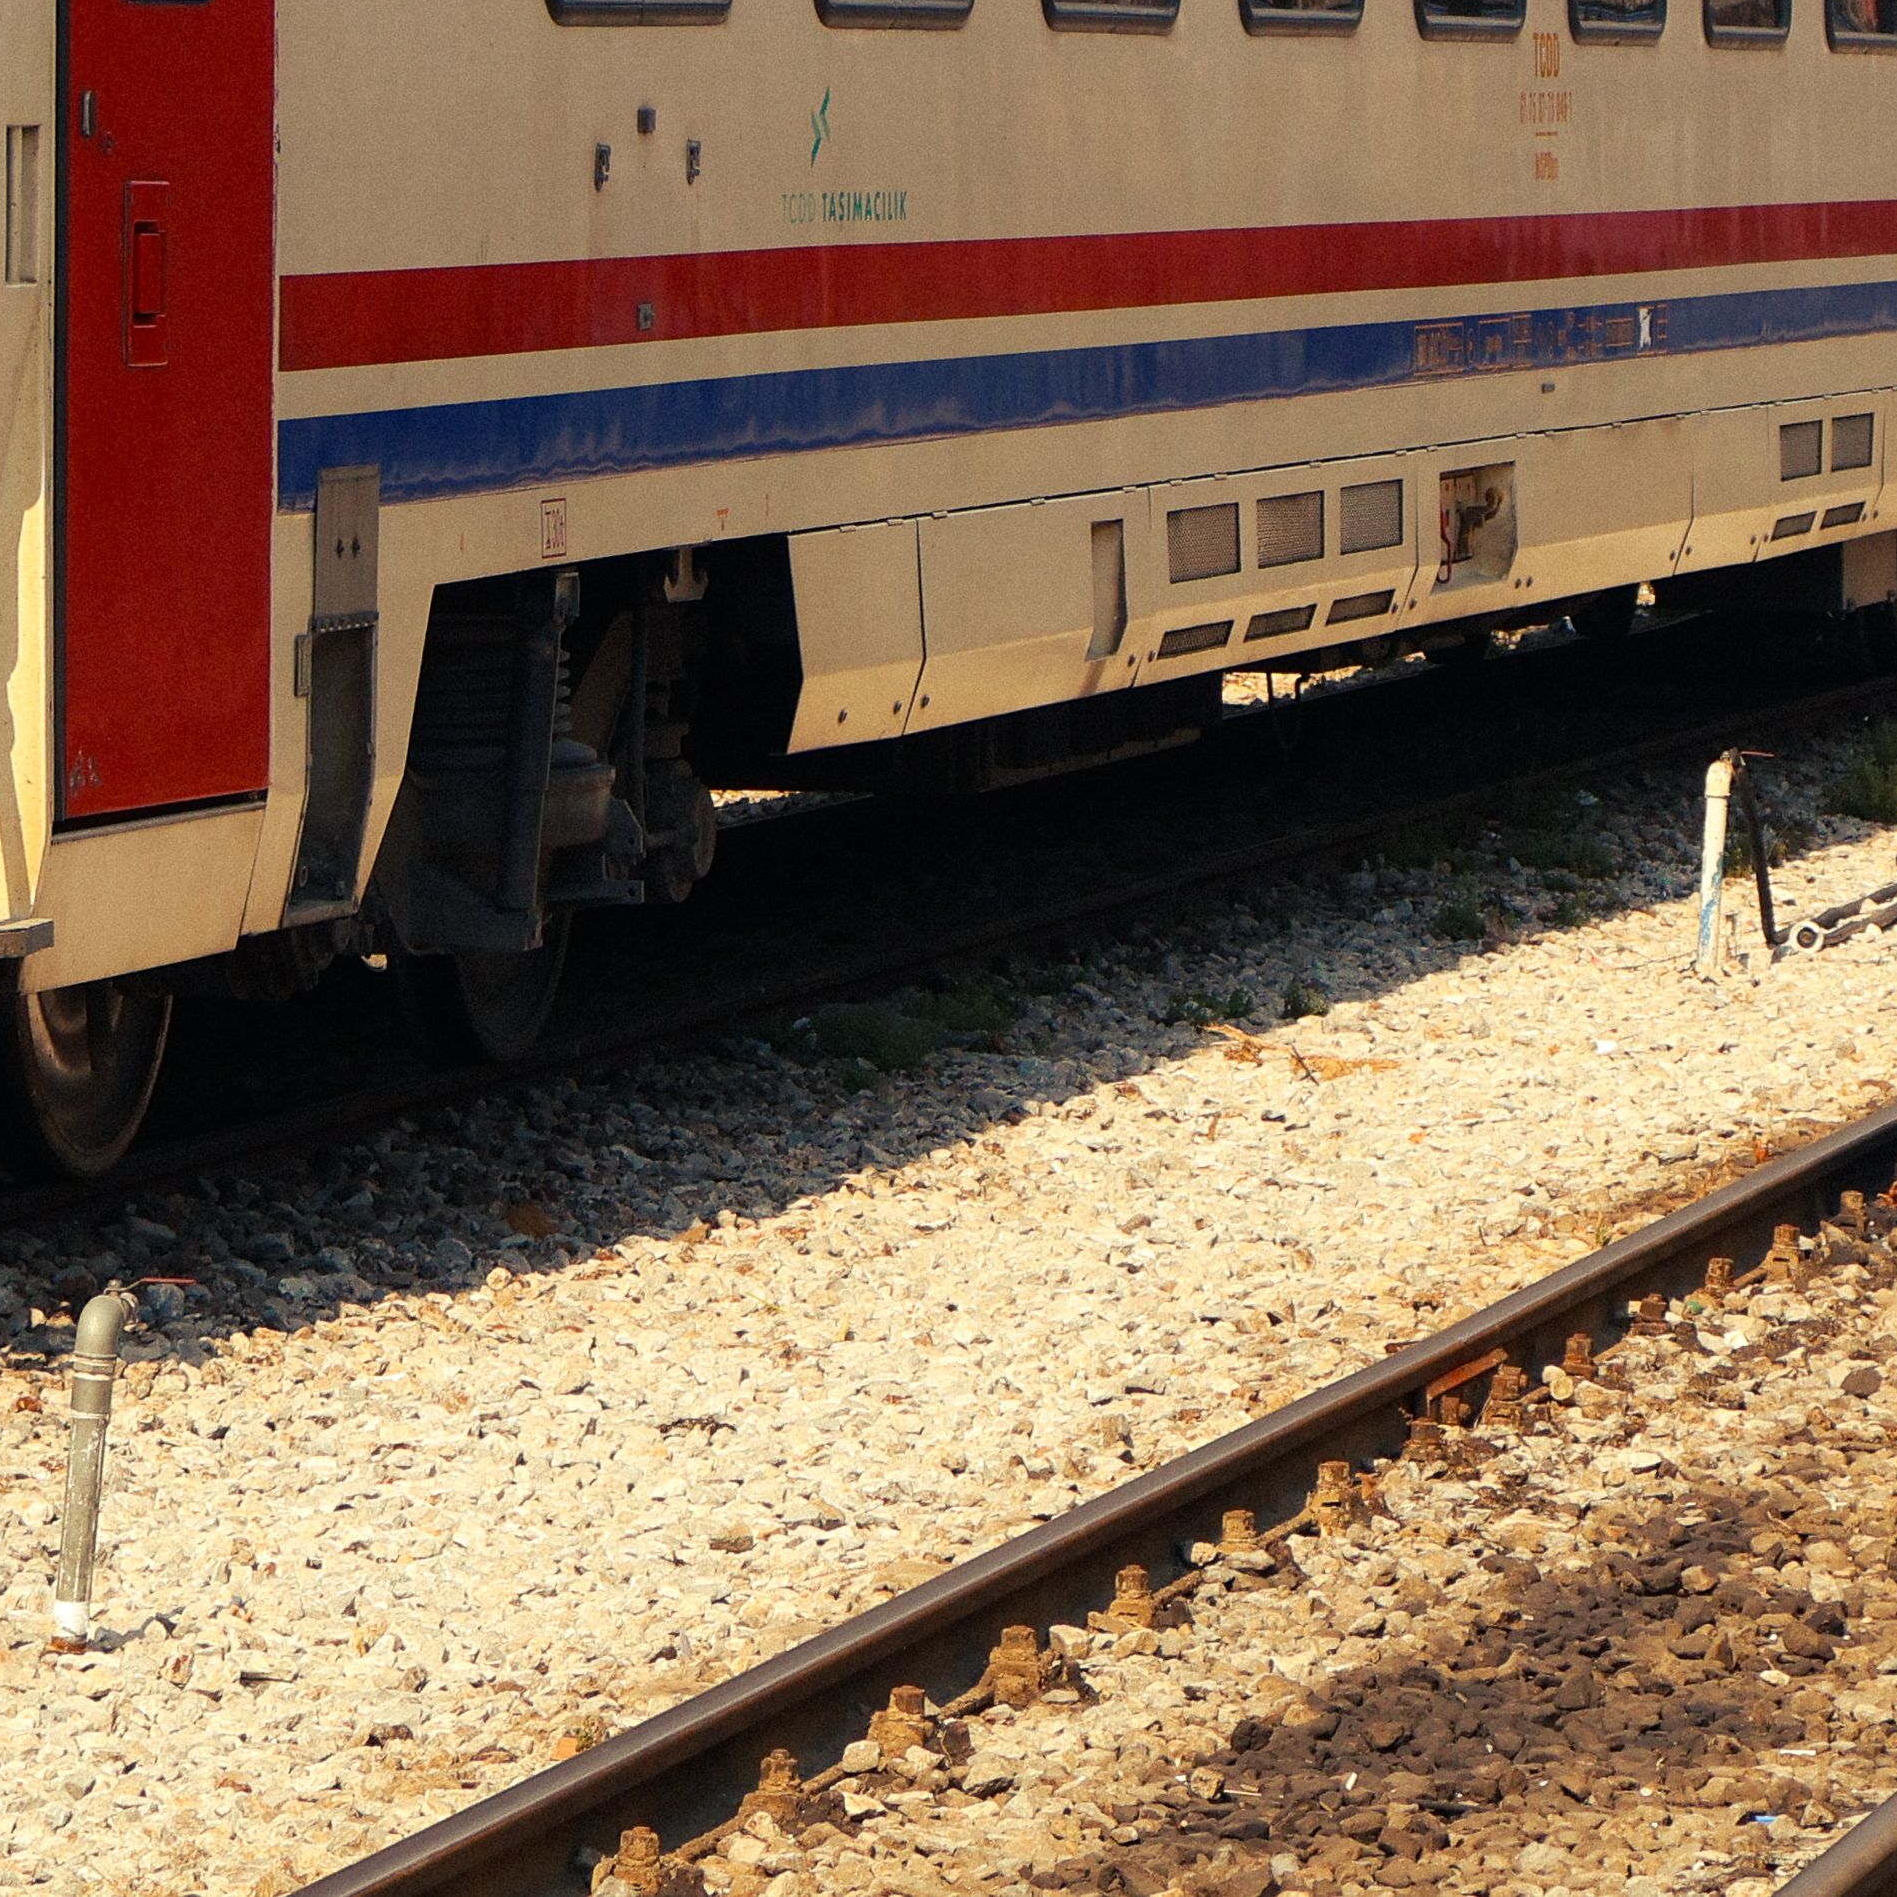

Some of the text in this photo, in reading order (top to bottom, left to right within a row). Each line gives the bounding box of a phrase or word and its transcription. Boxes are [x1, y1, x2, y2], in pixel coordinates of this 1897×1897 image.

[1532, 32, 1560, 78] TCDD
[780, 191, 907, 230] TCDD TAŞIMACILIK
